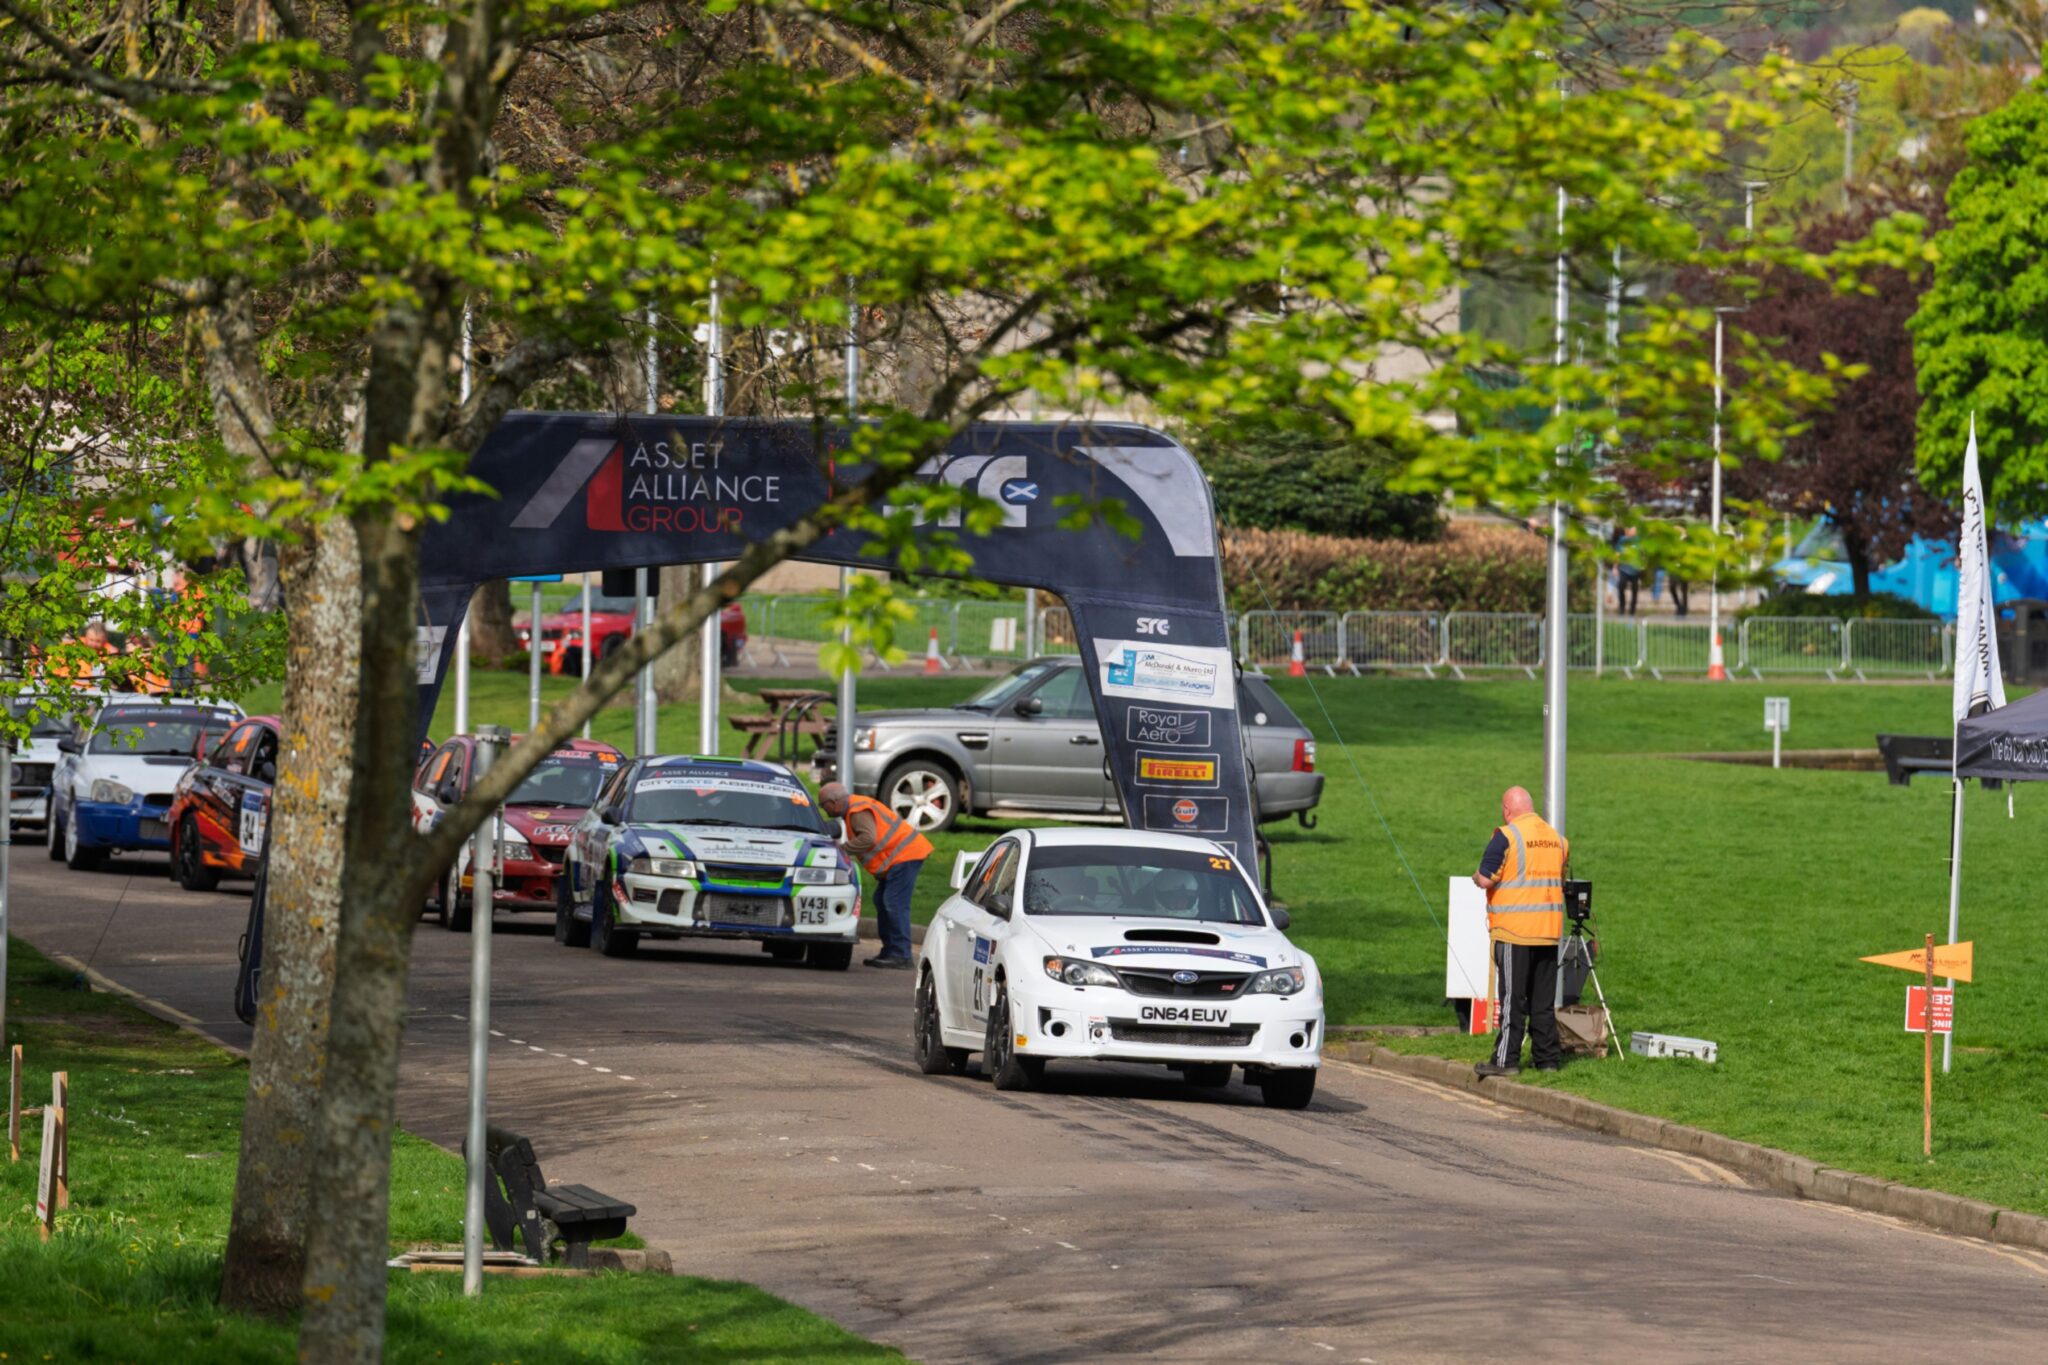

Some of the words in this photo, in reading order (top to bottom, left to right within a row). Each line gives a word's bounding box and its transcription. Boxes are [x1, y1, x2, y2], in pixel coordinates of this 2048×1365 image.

[629, 441, 725, 469] ASSET
[628, 474, 780, 503] ALLIANCE
[627, 504, 744, 535] GROUP
[1144, 661, 1175, 673] McDonald
[1204, 666, 1214, 675] Ltd
[1139, 710, 1181, 728] Royal
[1137, 726, 1181, 744] Aero
[1990, 737, 2003, 761] The
[1147, 762, 1207, 778] PIRELLI
[1175, 806, 1198, 815] Gulf
[1209, 856, 1231, 870] 27
[800, 897, 828, 910] V431
[800, 911, 825, 924] FLS
